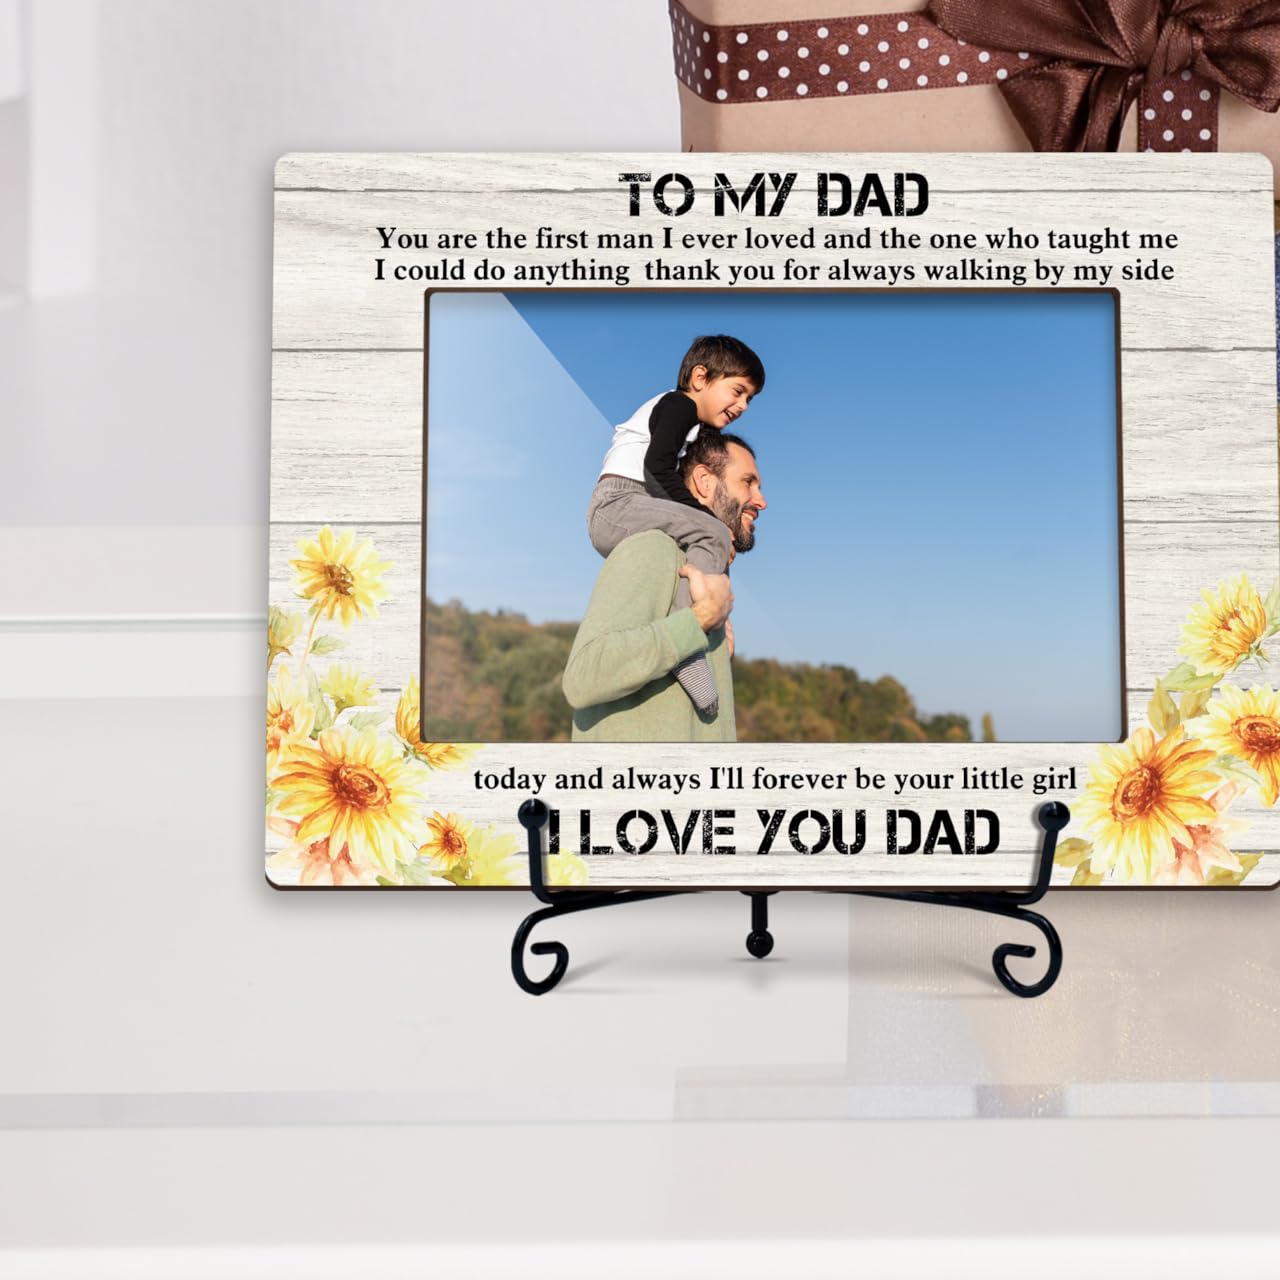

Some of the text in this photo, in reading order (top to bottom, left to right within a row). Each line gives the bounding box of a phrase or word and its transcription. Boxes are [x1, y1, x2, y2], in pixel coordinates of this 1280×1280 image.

[618, 172, 929, 217] TO MY DAD
[375, 226, 1178, 254] You are the first man I ever loved and the one who taught me
[375, 258, 1174, 286] I could do anything thank you for always walking by my side
[474, 766, 1077, 795] today and always I'll forever be your little girl
[548, 809, 1000, 855] I LOVE YOU DAD
